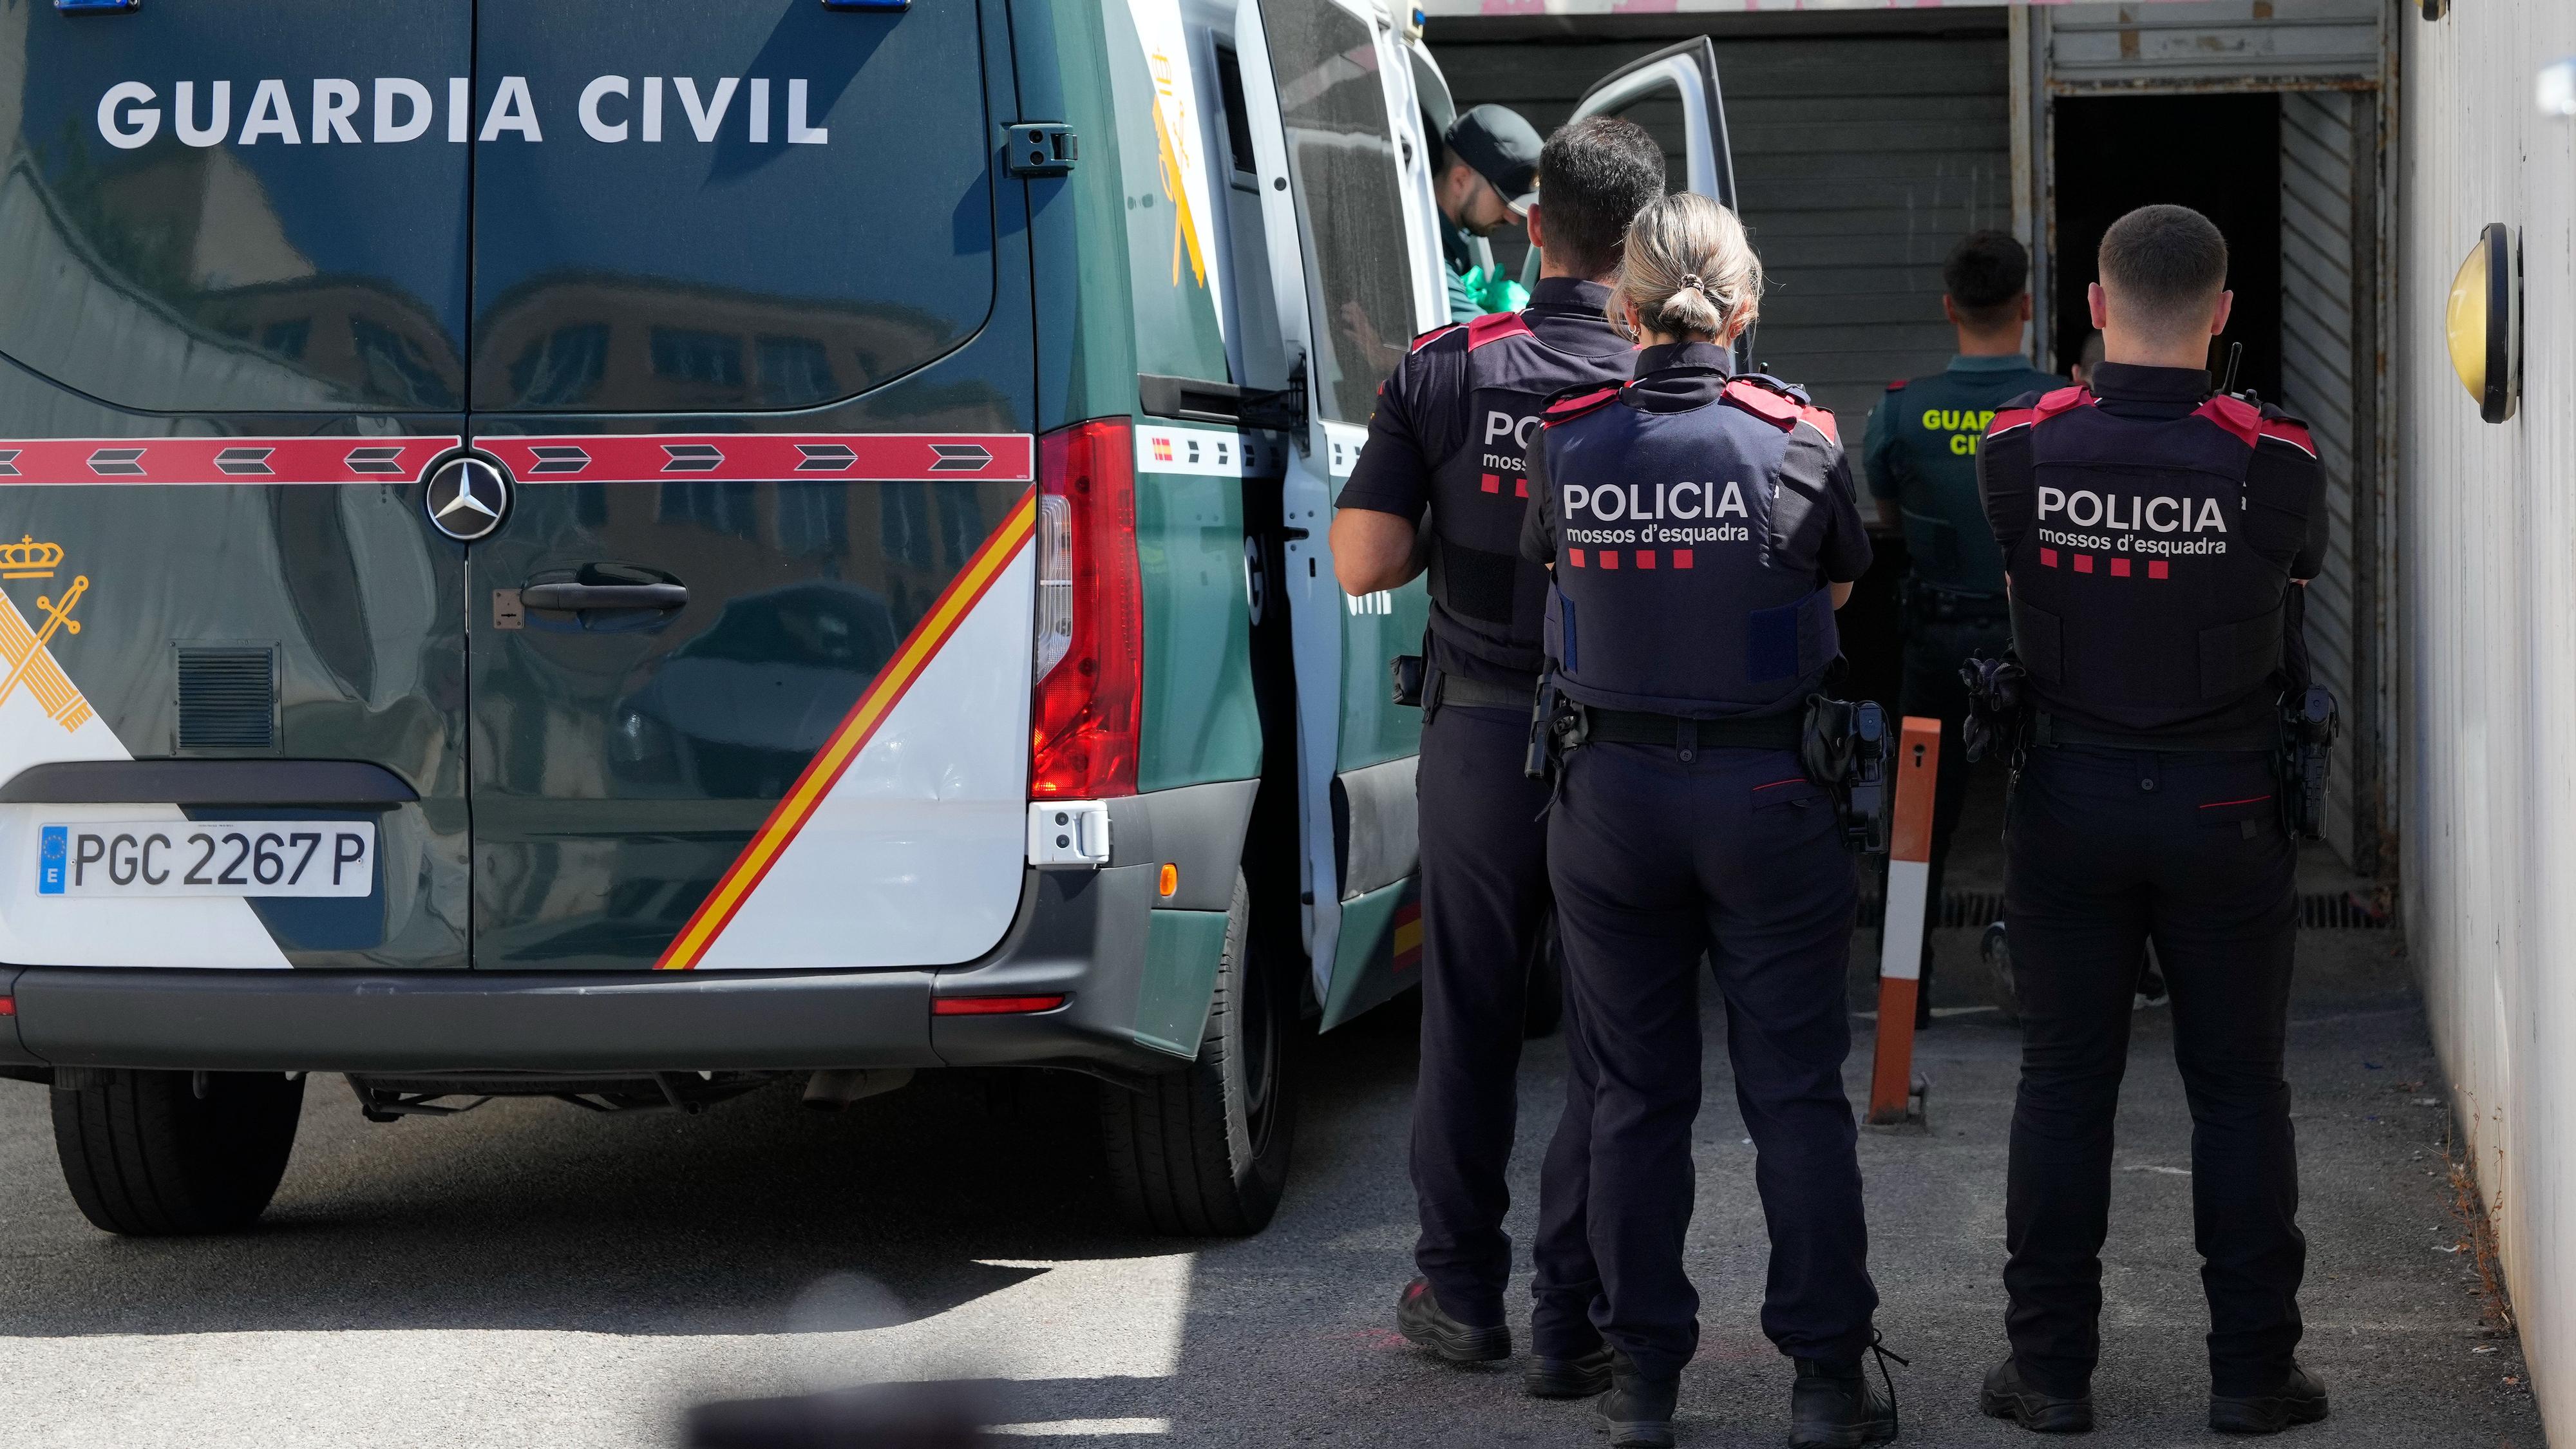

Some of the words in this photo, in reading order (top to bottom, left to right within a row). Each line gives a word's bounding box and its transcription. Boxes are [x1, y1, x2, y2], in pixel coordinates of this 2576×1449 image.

[98, 76, 542, 149] GUARDIA
[578, 75, 828, 144] CIVIL
[1564, 482, 1748, 521] POLICIA
[2038, 486, 2227, 533] POLICIA
[1567, 528, 1635, 544] mossos
[1642, 523, 1748, 545] d'esquadra
[2039, 528, 2111, 550] mossos
[2117, 534, 2226, 557] d'esquadra
[47, 868, 58, 883] E
[75, 833, 171, 886] PGC
[184, 833, 321, 885] 2267
[333, 833, 365, 885] P
